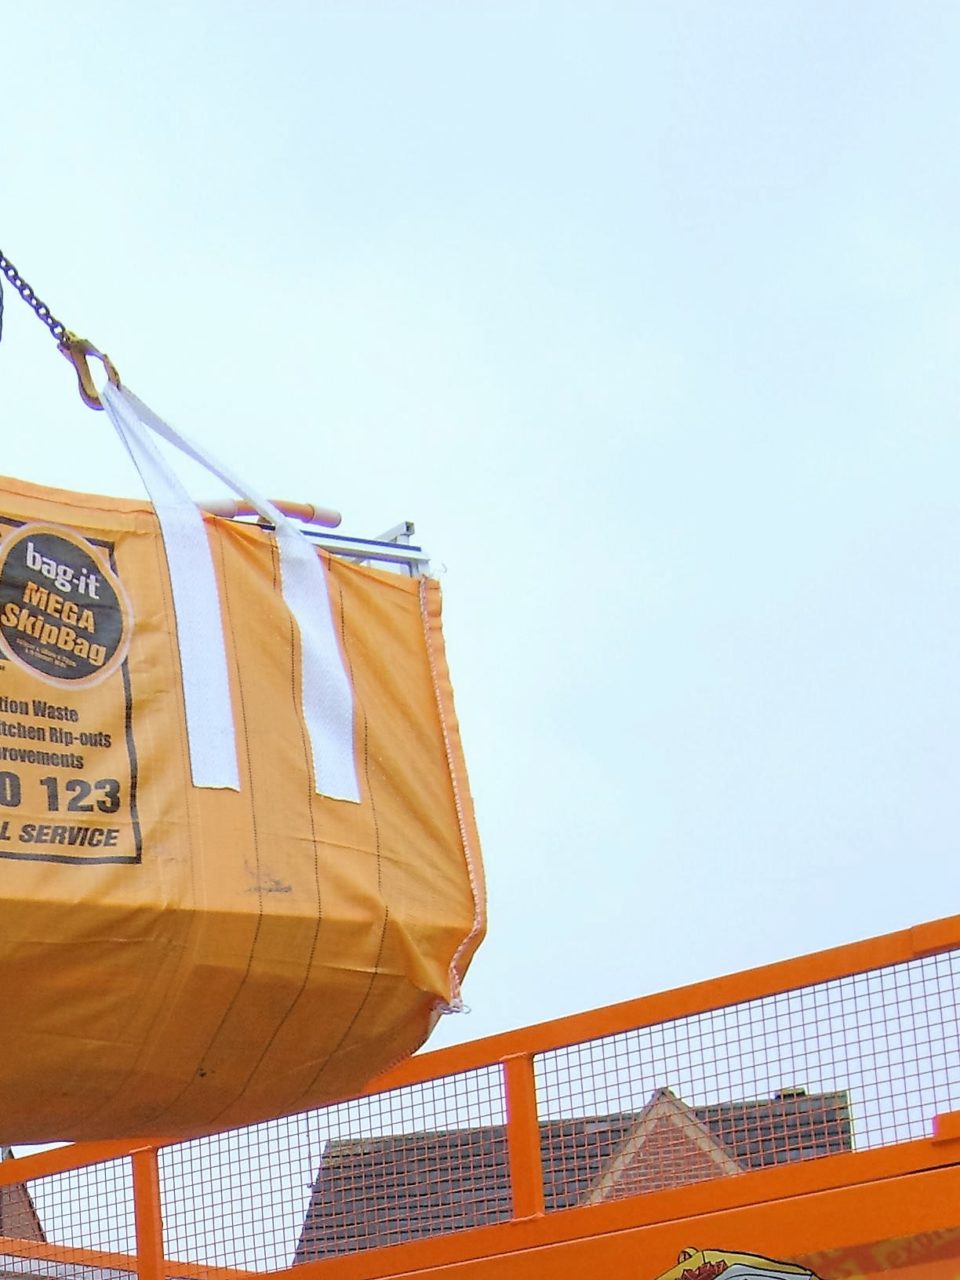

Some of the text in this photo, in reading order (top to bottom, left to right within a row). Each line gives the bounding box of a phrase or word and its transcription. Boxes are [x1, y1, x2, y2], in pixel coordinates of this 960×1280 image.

[26, 542, 100, 599] bag-it
[23, 581, 95, 634] MEGA
[0, 603, 107, 666] SkipBag
[32, 699, 79, 723] Waste
[49, 725, 112, 748] Rip-outs
[40, 777, 121, 814] 123
[18, 825, 120, 848] SERVICE
